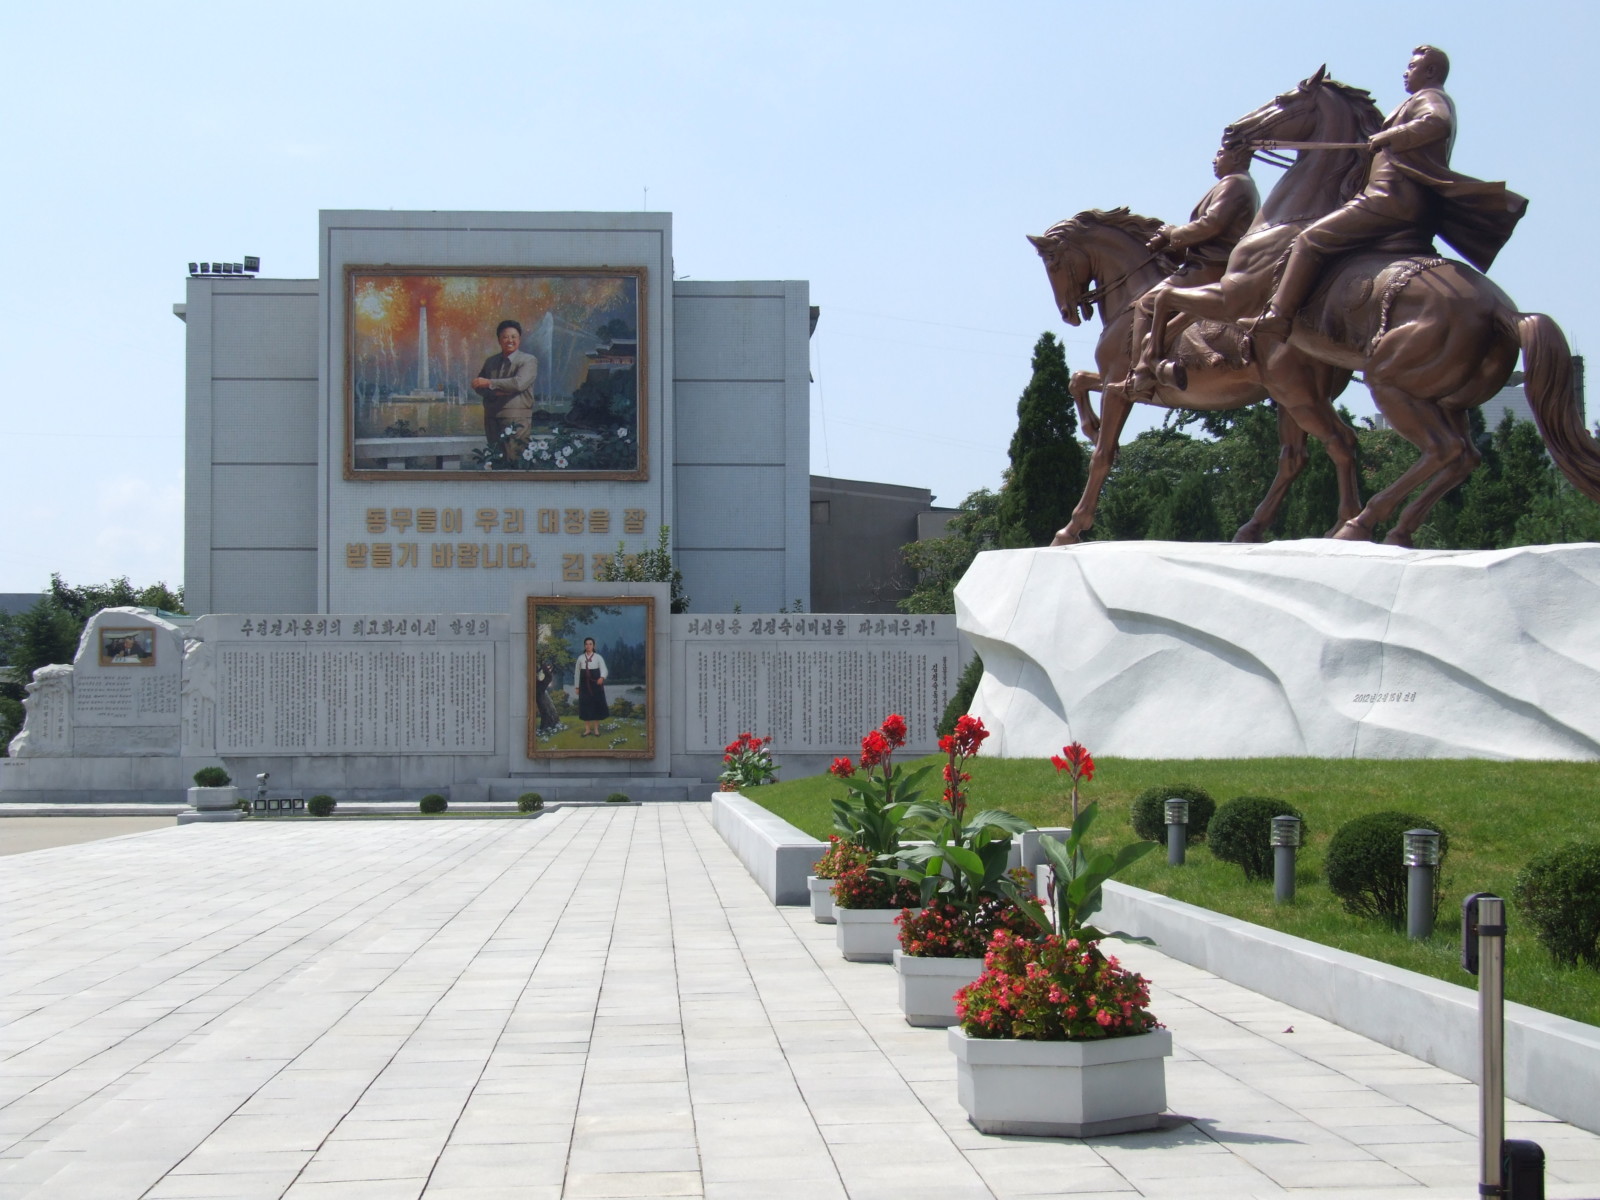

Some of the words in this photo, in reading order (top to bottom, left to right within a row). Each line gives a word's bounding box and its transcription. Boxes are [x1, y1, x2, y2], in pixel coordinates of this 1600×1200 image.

[366, 508, 463, 533] 동무들이
[475, 508, 524, 533] 우리
[538, 508, 610, 533] 대장을
[624, 508, 647, 533] 잘
[346, 542, 418, 568] 받들기
[432, 542, 536, 568] 바람니다.
[241, 619, 341, 636] 수령결사옹위의
[353, 619, 436, 636] 최고화신이신
[449, 618, 490, 636] 항일의
[749, 618, 846, 636] 김정숙어머님을
[858, 618, 936, 636] 따라배우자!
